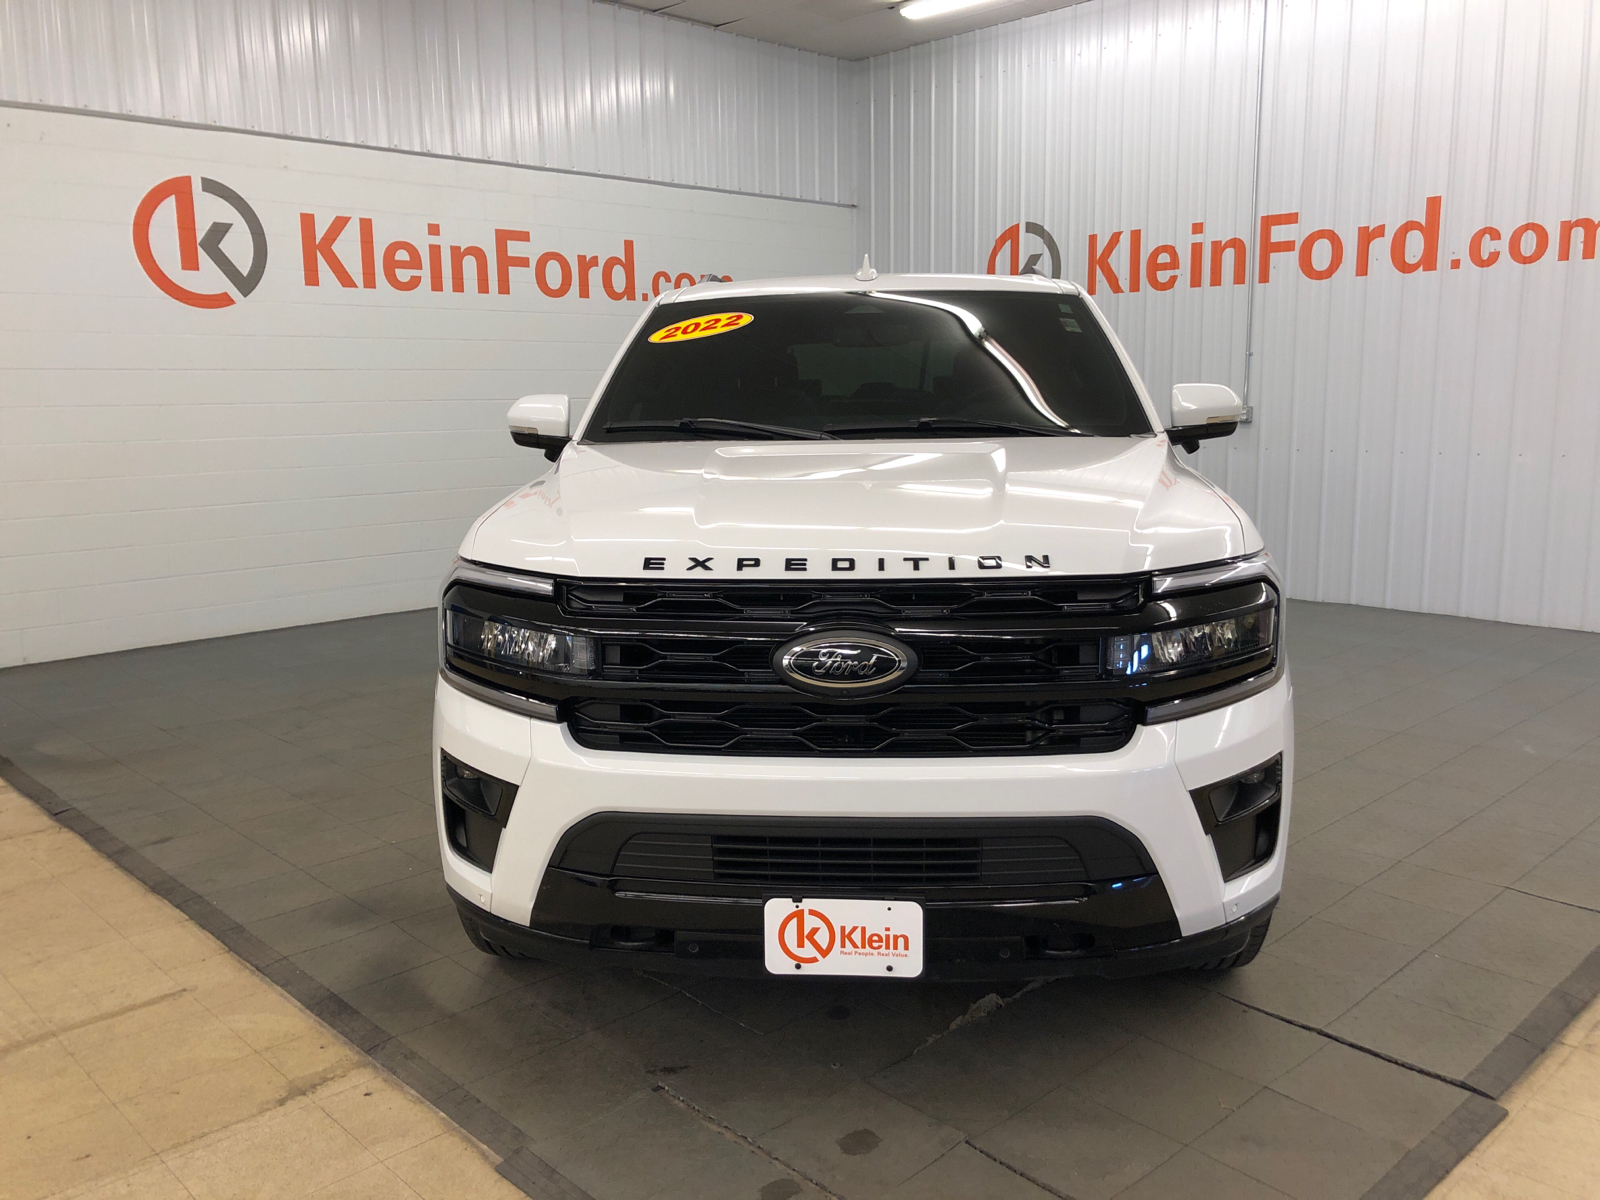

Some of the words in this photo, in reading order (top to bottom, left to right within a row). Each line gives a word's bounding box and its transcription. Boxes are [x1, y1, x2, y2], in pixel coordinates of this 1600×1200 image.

[300, 212, 733, 302] KleinFord.co
[659, 314, 744, 341] 2022
[642, 554, 1051, 572] EXPEDITION
[811, 647, 878, 676] Ford
[840, 925, 910, 951] Klein
